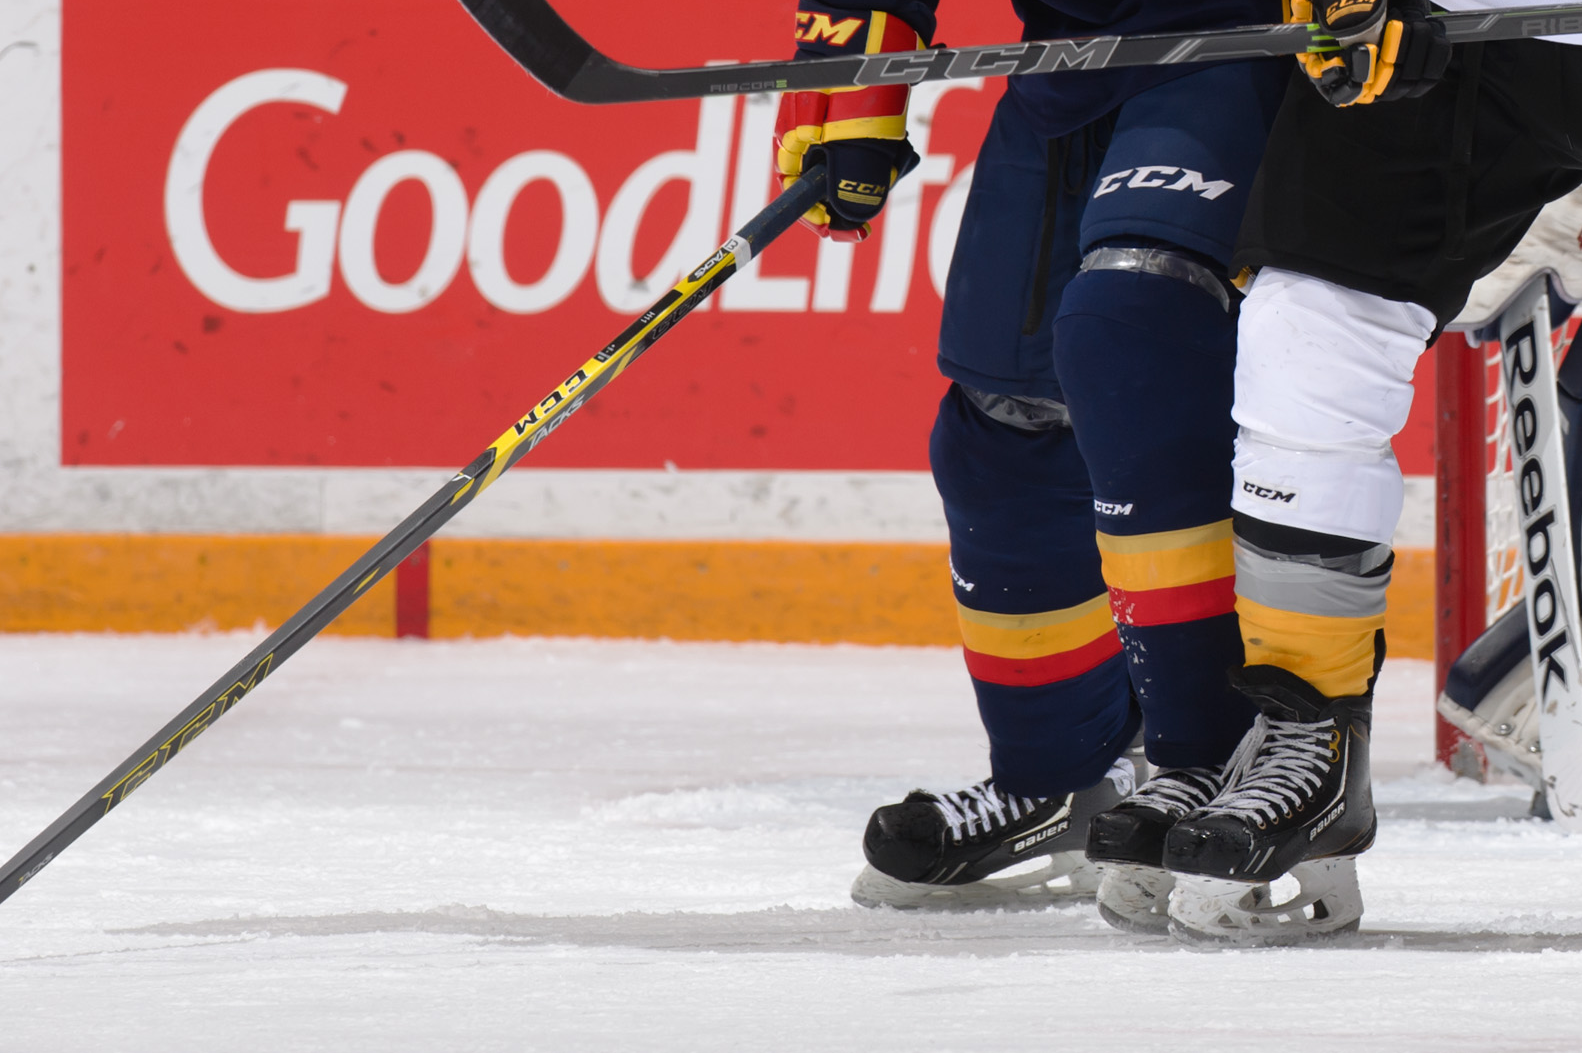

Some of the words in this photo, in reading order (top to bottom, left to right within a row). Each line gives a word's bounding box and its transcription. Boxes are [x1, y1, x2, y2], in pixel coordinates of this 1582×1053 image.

[853, 36, 1122, 87] CCM
[837, 178, 887, 194] CCM
[1093, 164, 1236, 200] CCM
[513, 367, 590, 437] CCM
[1094, 498, 1134, 516] CCM
[1243, 480, 1297, 505] CCM
[1504, 320, 1570, 713] Reebok
[1014, 821, 1069, 853] BAUER
[1309, 800, 1346, 841] BAUER
